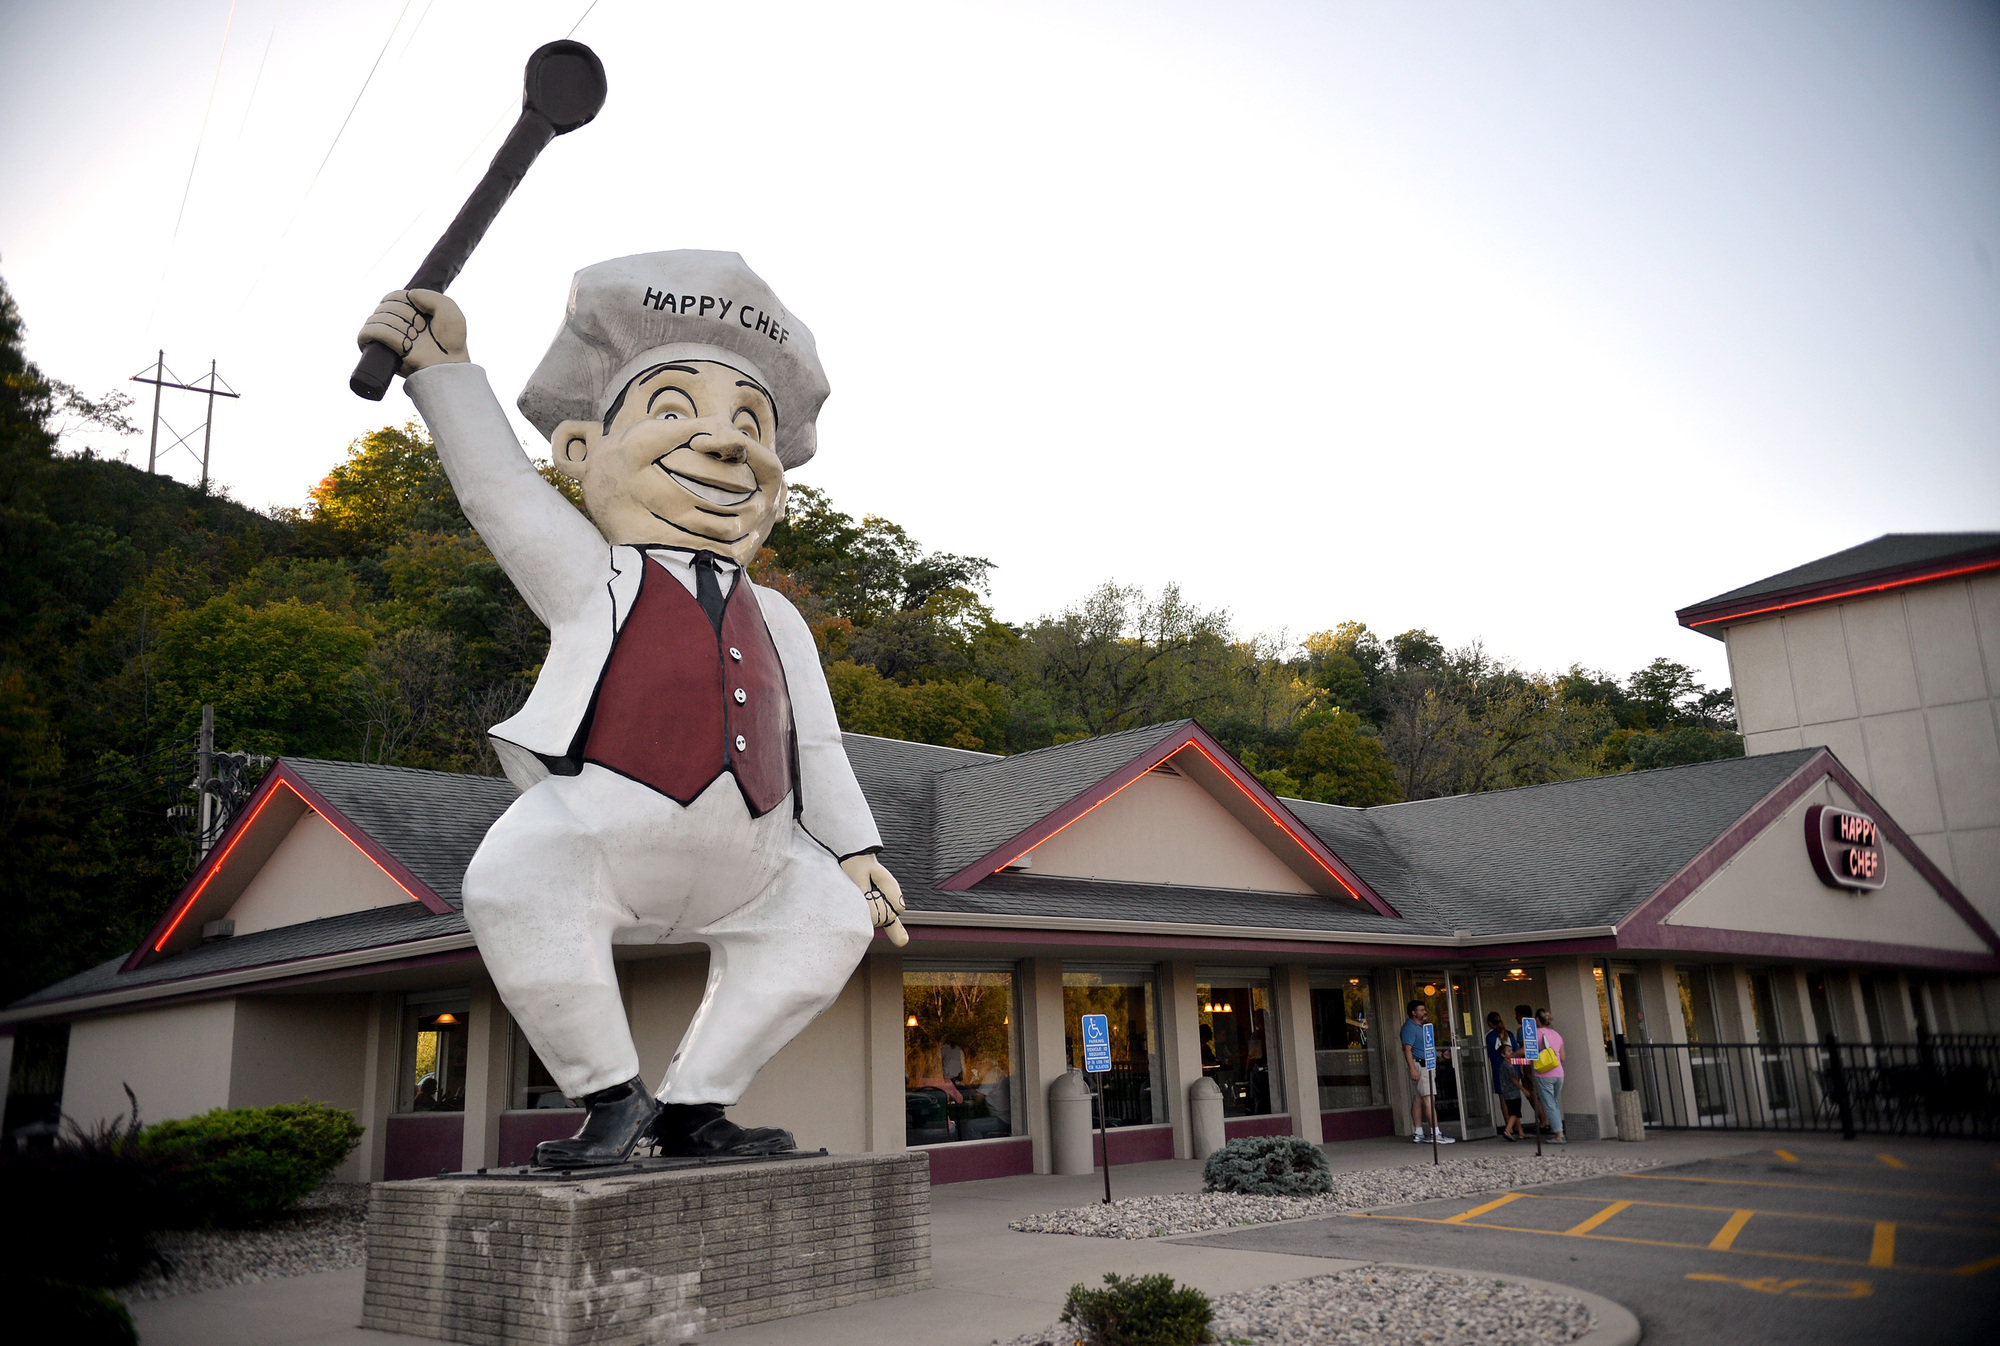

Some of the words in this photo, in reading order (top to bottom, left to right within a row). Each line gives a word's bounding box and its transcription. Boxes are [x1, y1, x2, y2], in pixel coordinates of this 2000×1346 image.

[643, 286, 733, 320] HAPPY
[739, 305, 790, 345] CHEF
[1841, 813, 1877, 846] HAPPY
[1849, 847, 1878, 878] CHEF
